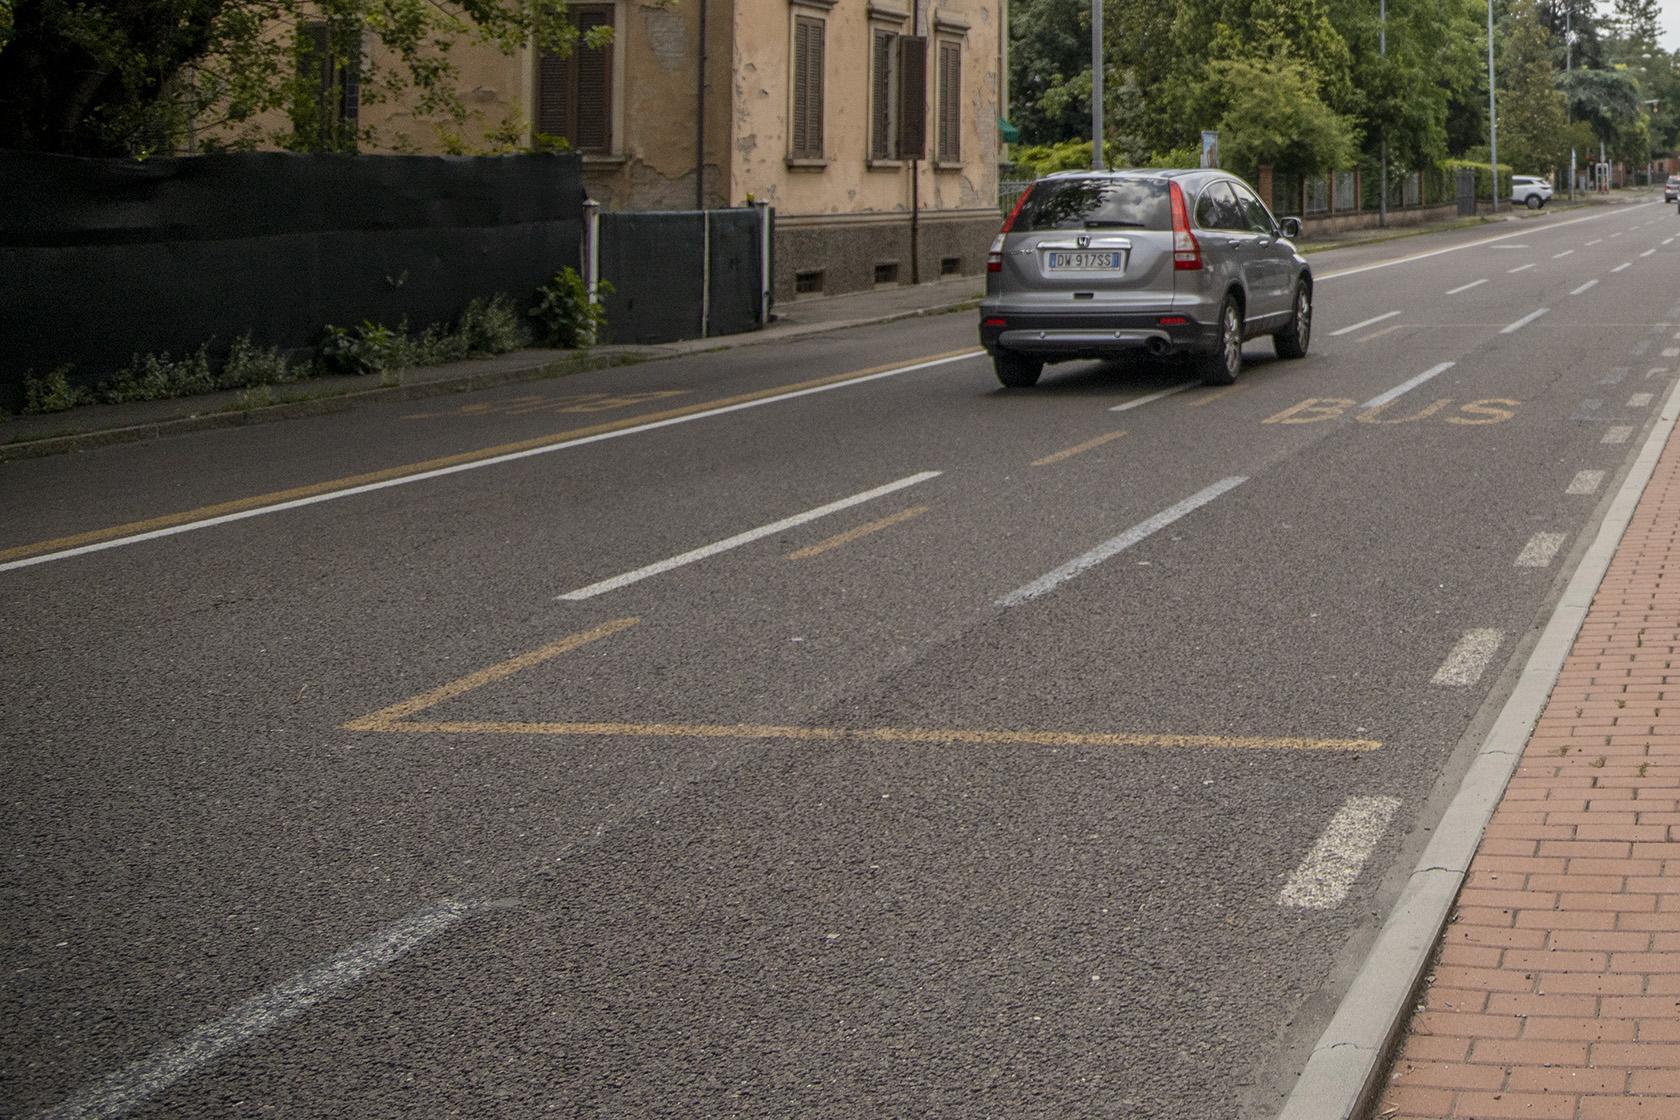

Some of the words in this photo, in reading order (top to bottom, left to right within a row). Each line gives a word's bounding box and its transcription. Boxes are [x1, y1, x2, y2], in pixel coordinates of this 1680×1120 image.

[1057, 254, 1072, 267] DW
[1075, 254, 1111, 267] 917SS
[1261, 397, 1521, 425] BUS
